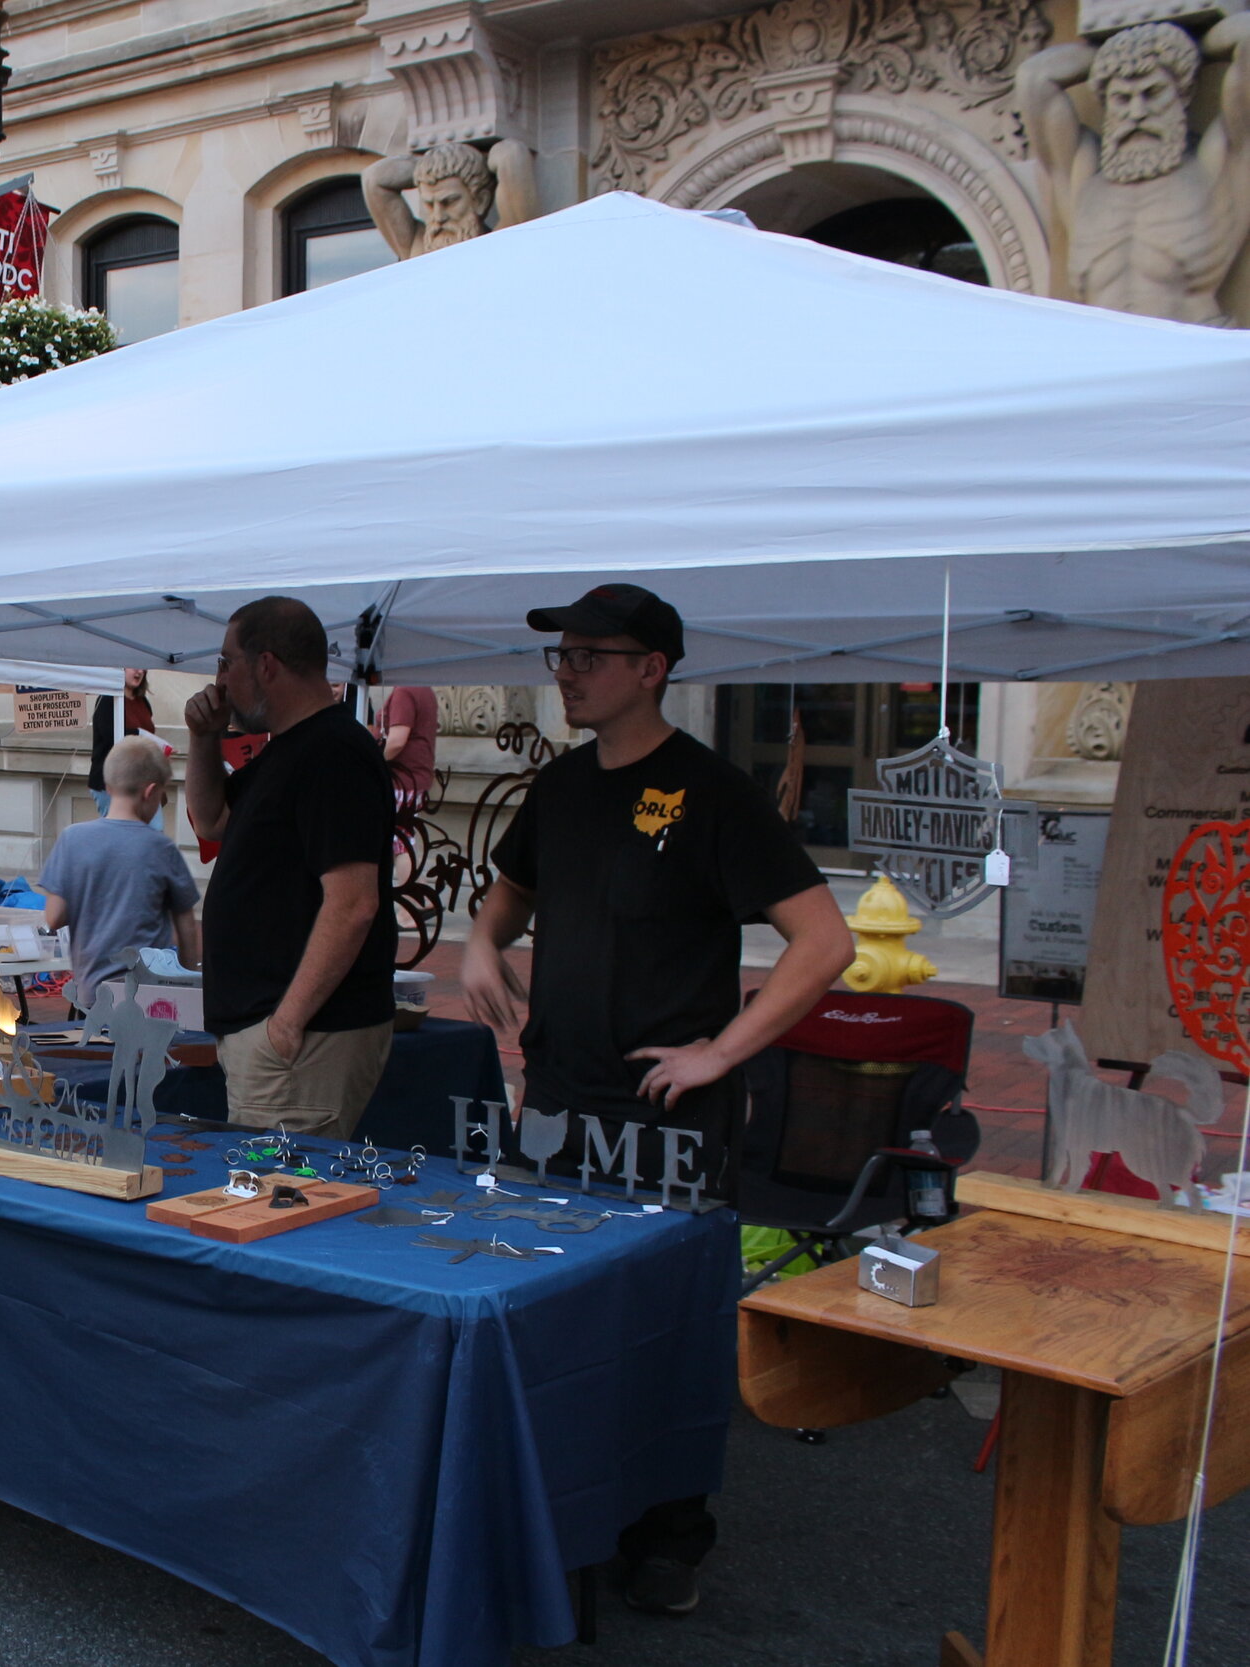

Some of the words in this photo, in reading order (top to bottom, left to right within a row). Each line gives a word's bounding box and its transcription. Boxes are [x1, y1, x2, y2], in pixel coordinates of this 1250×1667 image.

[30, 692, 69, 702] SHOPLIFTERS
[19, 704, 33, 712] WILL
[34, 703, 42, 711] BE
[43, 700, 81, 710] PROSECUTED
[28, 712, 36, 720] TO
[37, 711, 48, 719] THE
[49, 710, 73, 718] FULLEST
[23, 721, 44, 730] EXTENT
[45, 720, 52, 728] OF
[54, 719, 64, 727] THE
[66, 718, 79, 727] LAW
[896, 759, 980, 801] MOTOR
[1144, 806, 1237, 820] Commercial
[39, 1118, 104, 1165] 2020
